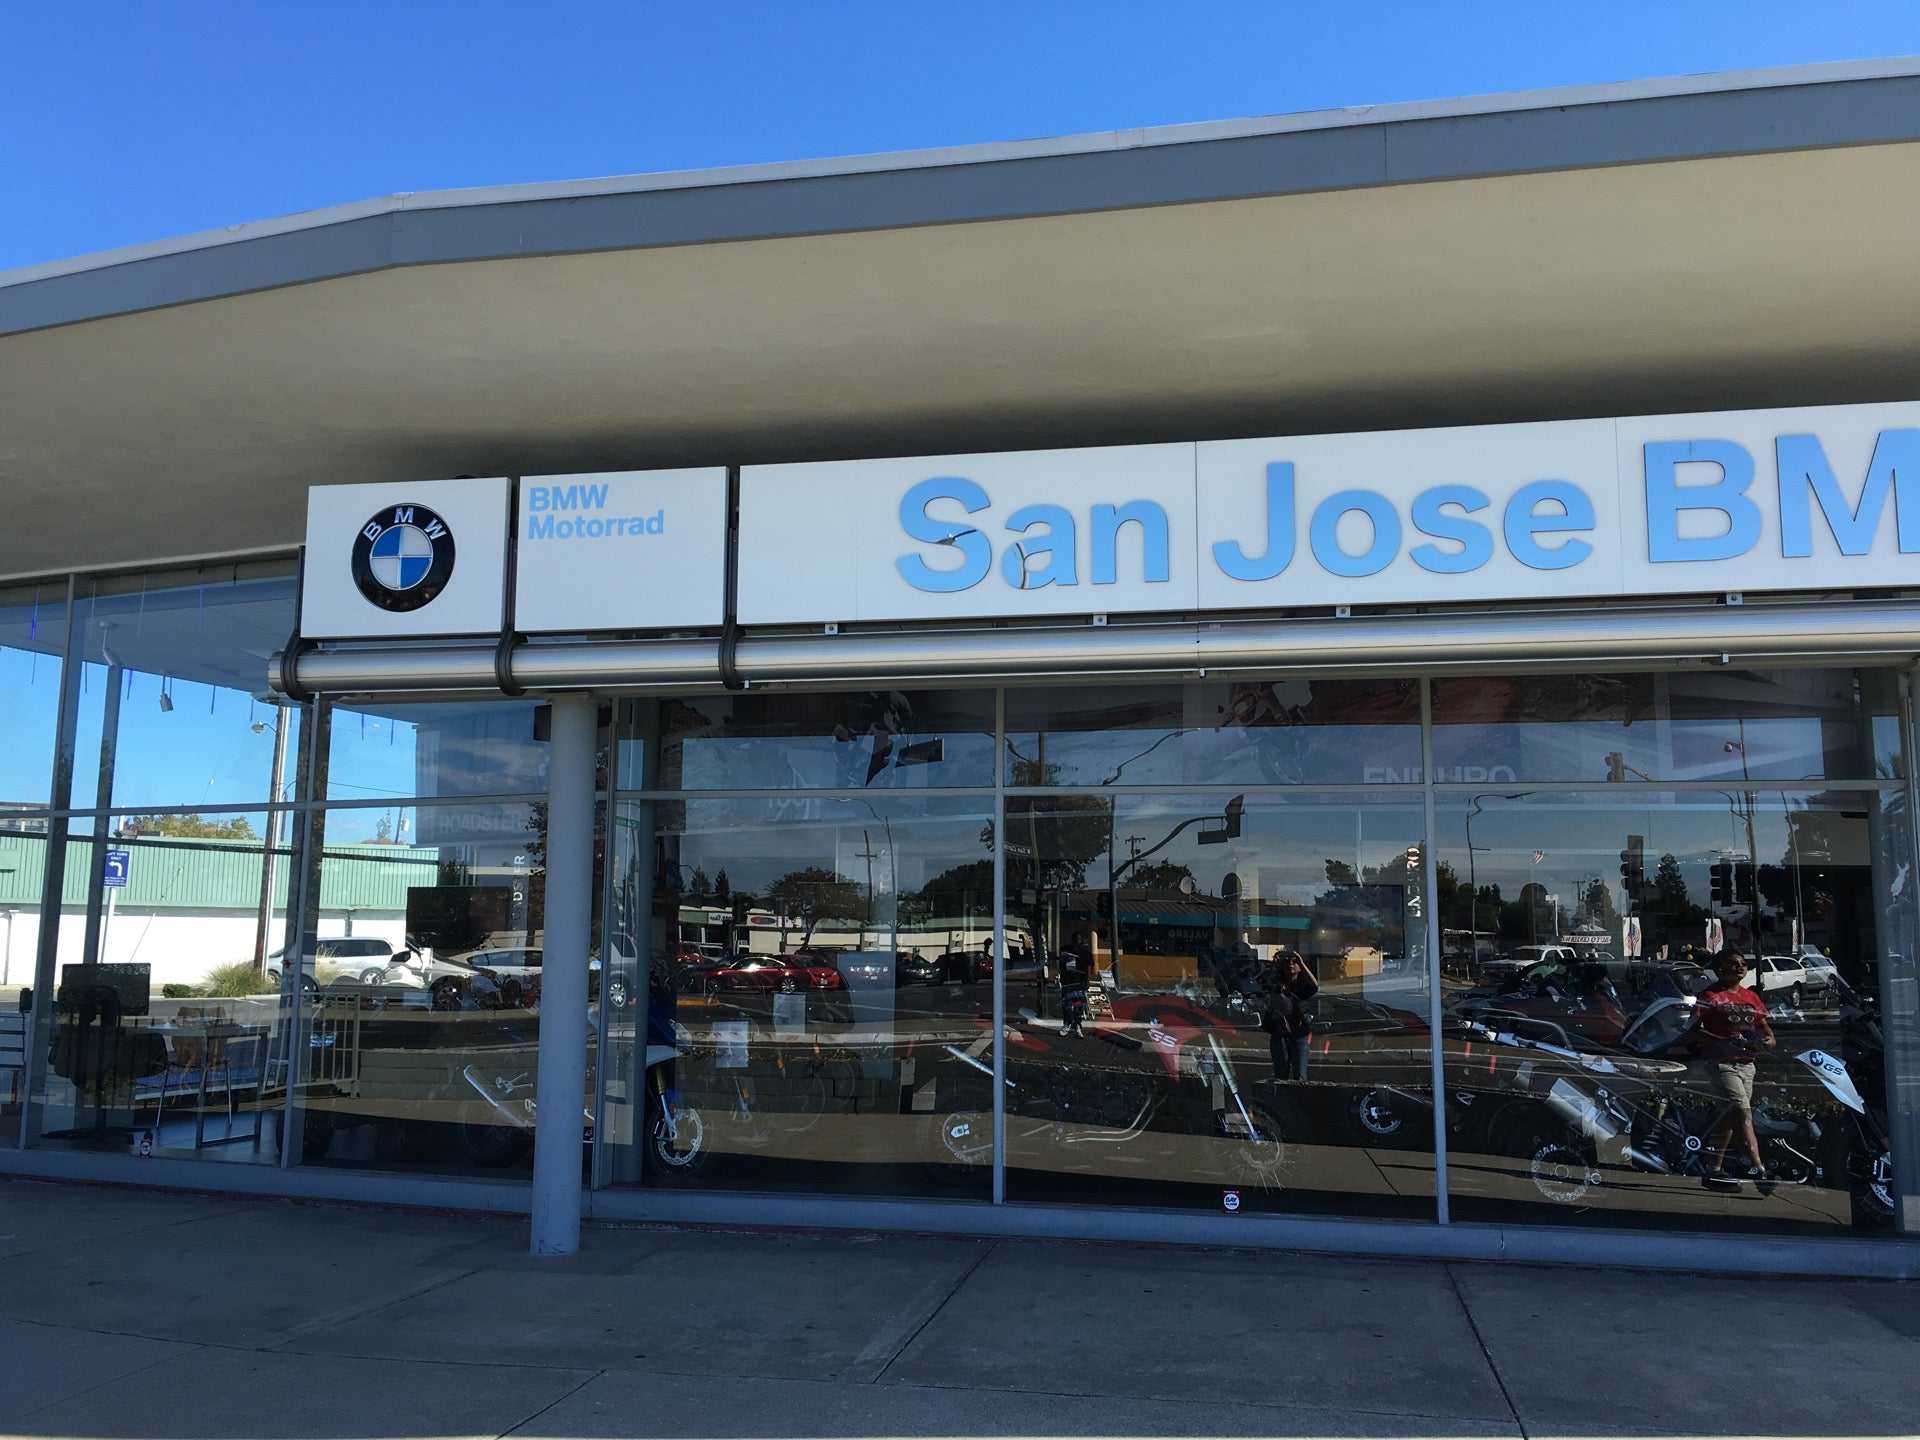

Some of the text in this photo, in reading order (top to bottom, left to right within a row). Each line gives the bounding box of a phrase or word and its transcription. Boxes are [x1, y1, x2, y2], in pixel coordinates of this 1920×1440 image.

[528, 484, 609, 513] BMW
[362, 506, 448, 543] BMW
[528, 510, 665, 540] Motorrad
[895, 476, 1170, 593] San
[1212, 461, 1596, 582] Jose
[1147, 1029, 1178, 1048] GS
[1823, 1063, 1844, 1076] GS
